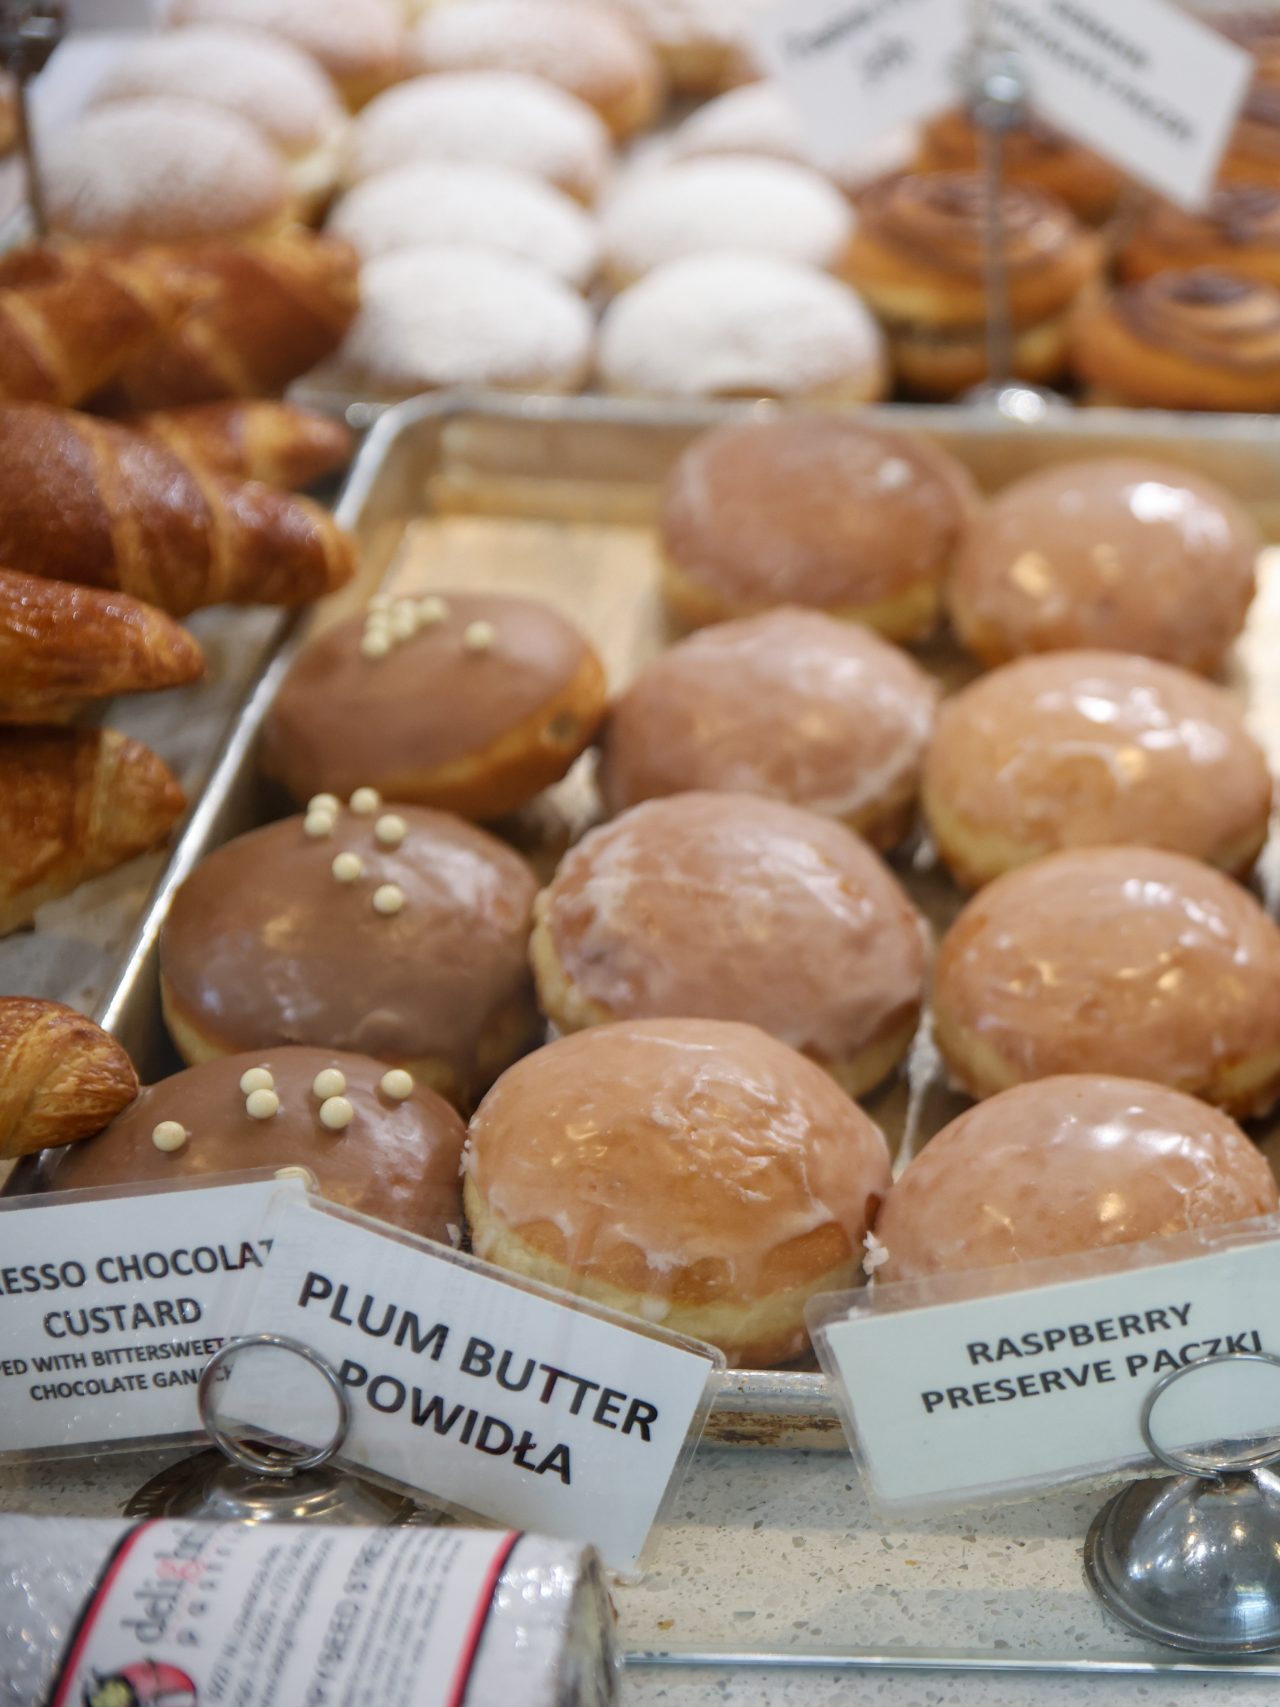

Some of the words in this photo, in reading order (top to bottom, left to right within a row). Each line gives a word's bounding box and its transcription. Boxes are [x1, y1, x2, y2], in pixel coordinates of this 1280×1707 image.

[0, 1261, 86, 1295] ESSO
[43, 1298, 201, 1338] CUSTARD
[966, 1303, 1192, 1365] RASPBERRY
[0, 1359, 28, 1377] ED
[32, 1353, 87, 1373] WITH
[92, 1338, 224, 1367] BITTERSWEET
[297, 1271, 449, 1361] PLUM
[459, 1336, 658, 1442] BUTTER
[30, 1375, 148, 1401] CHOCOLATE
[921, 1360, 1116, 1413] PRESERVE
[337, 1359, 571, 1485] POWIDŁA
